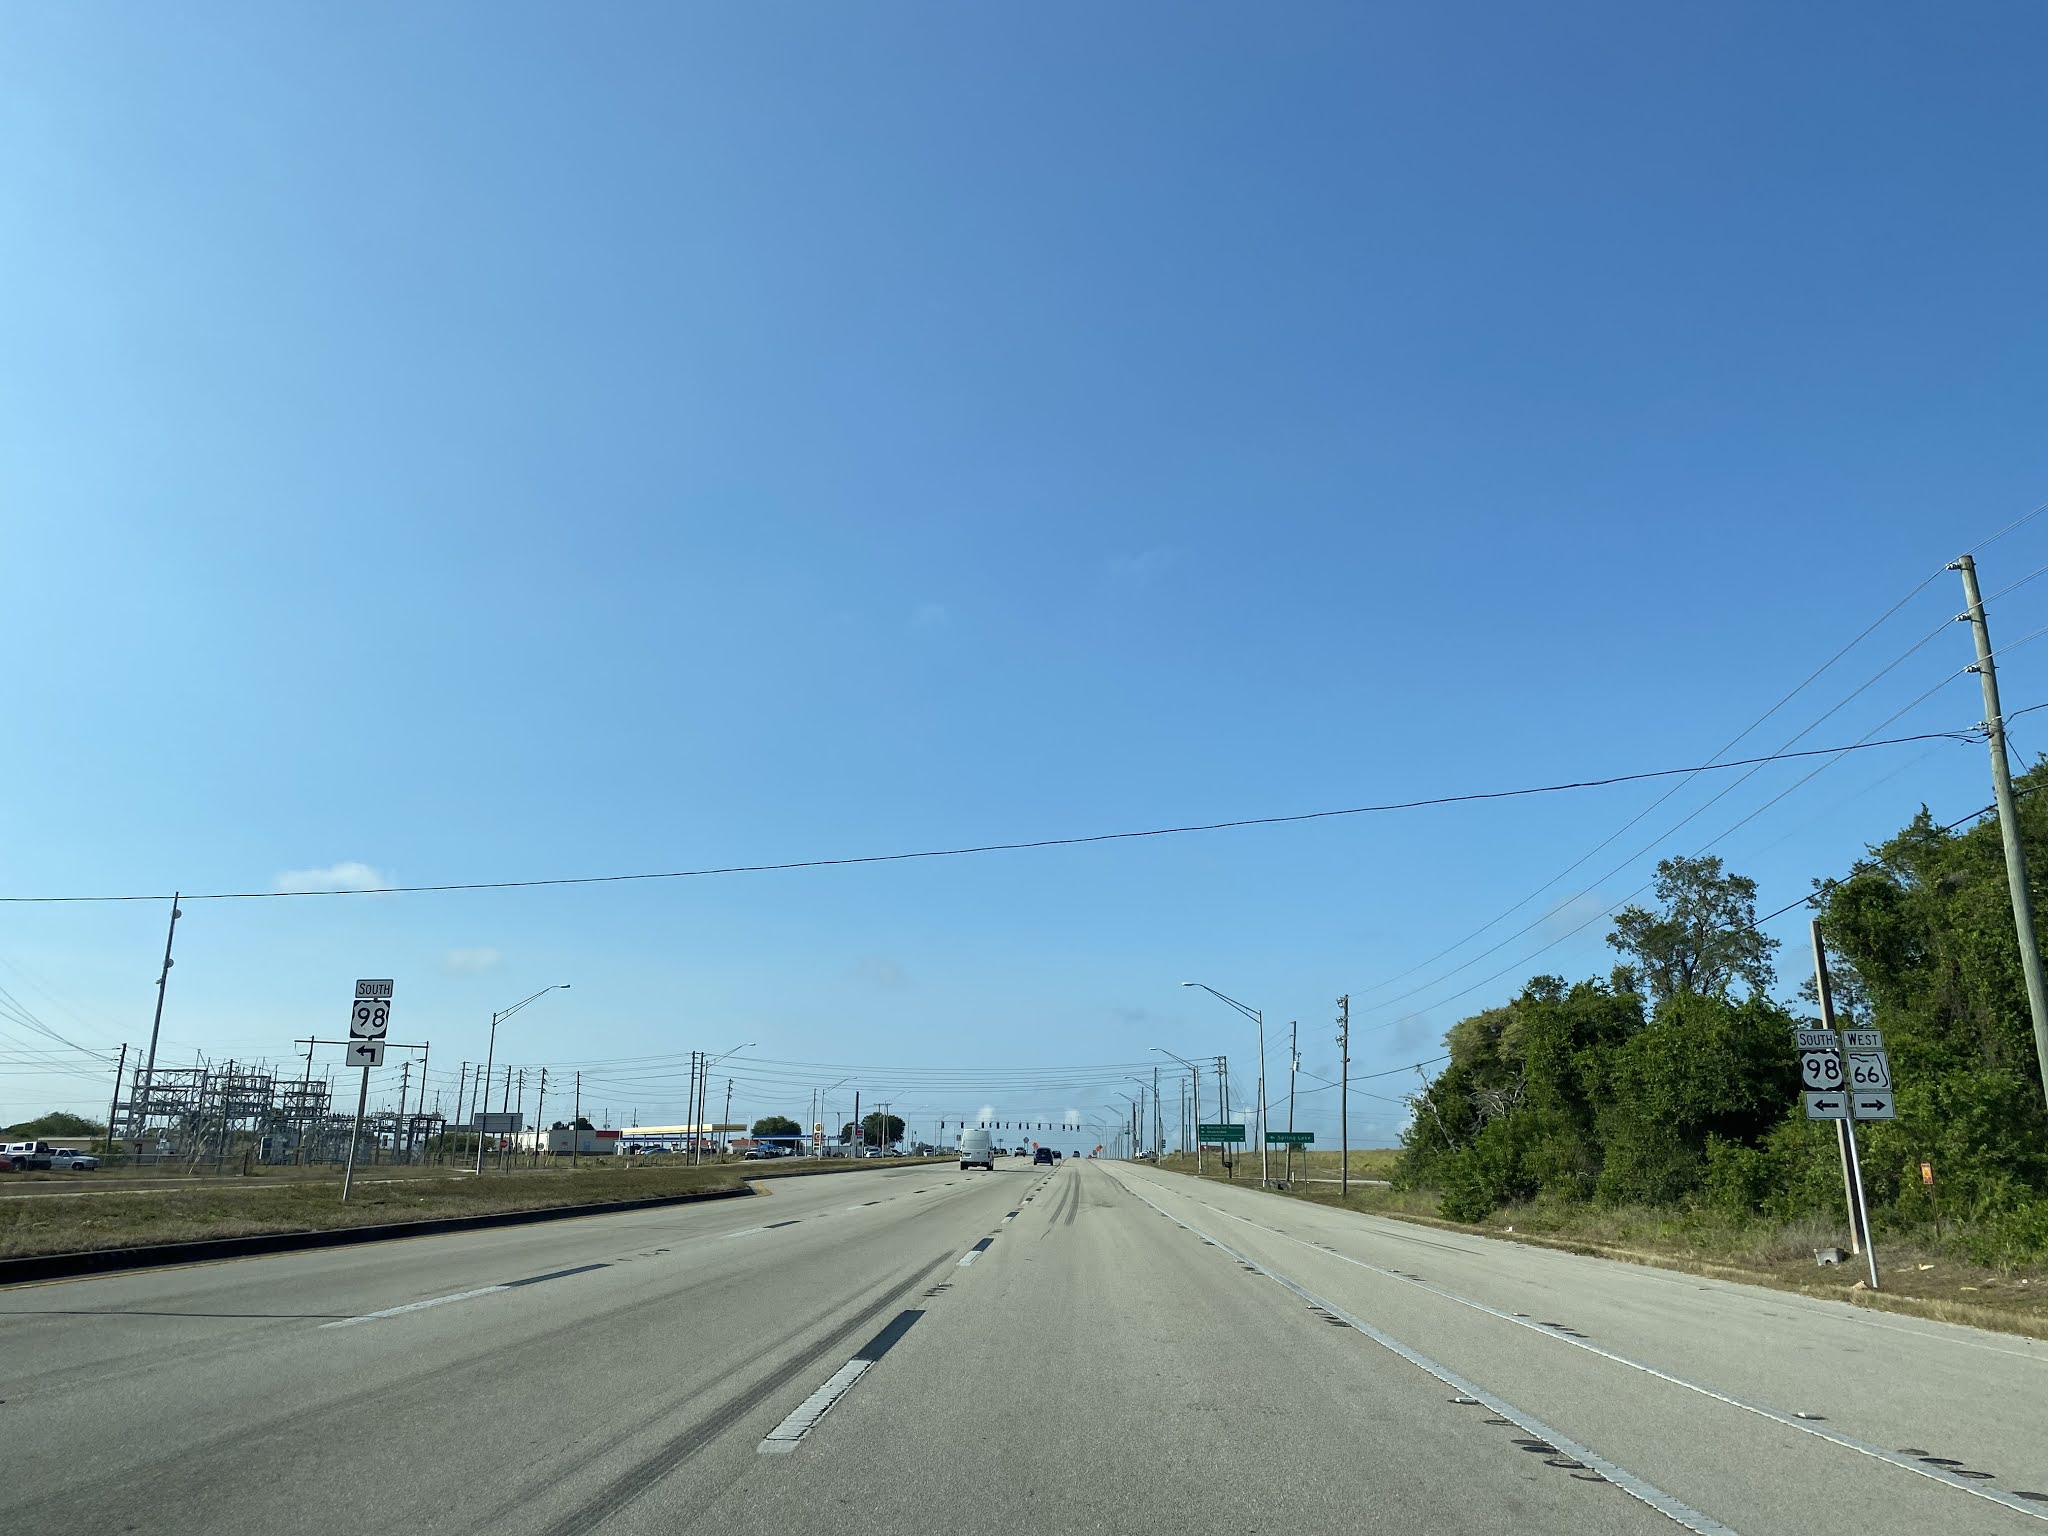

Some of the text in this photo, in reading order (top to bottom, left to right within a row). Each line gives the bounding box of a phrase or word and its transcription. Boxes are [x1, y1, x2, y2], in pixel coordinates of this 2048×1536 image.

[358, 982, 391, 995] SOUTH
[357, 1007, 386, 1028] 98
[1799, 1033, 1834, 1046] SOUTH
[1847, 1033, 1879, 1046] WEST
[1806, 1058, 1839, 1080] 98
[1854, 1066, 1880, 1083] 66
